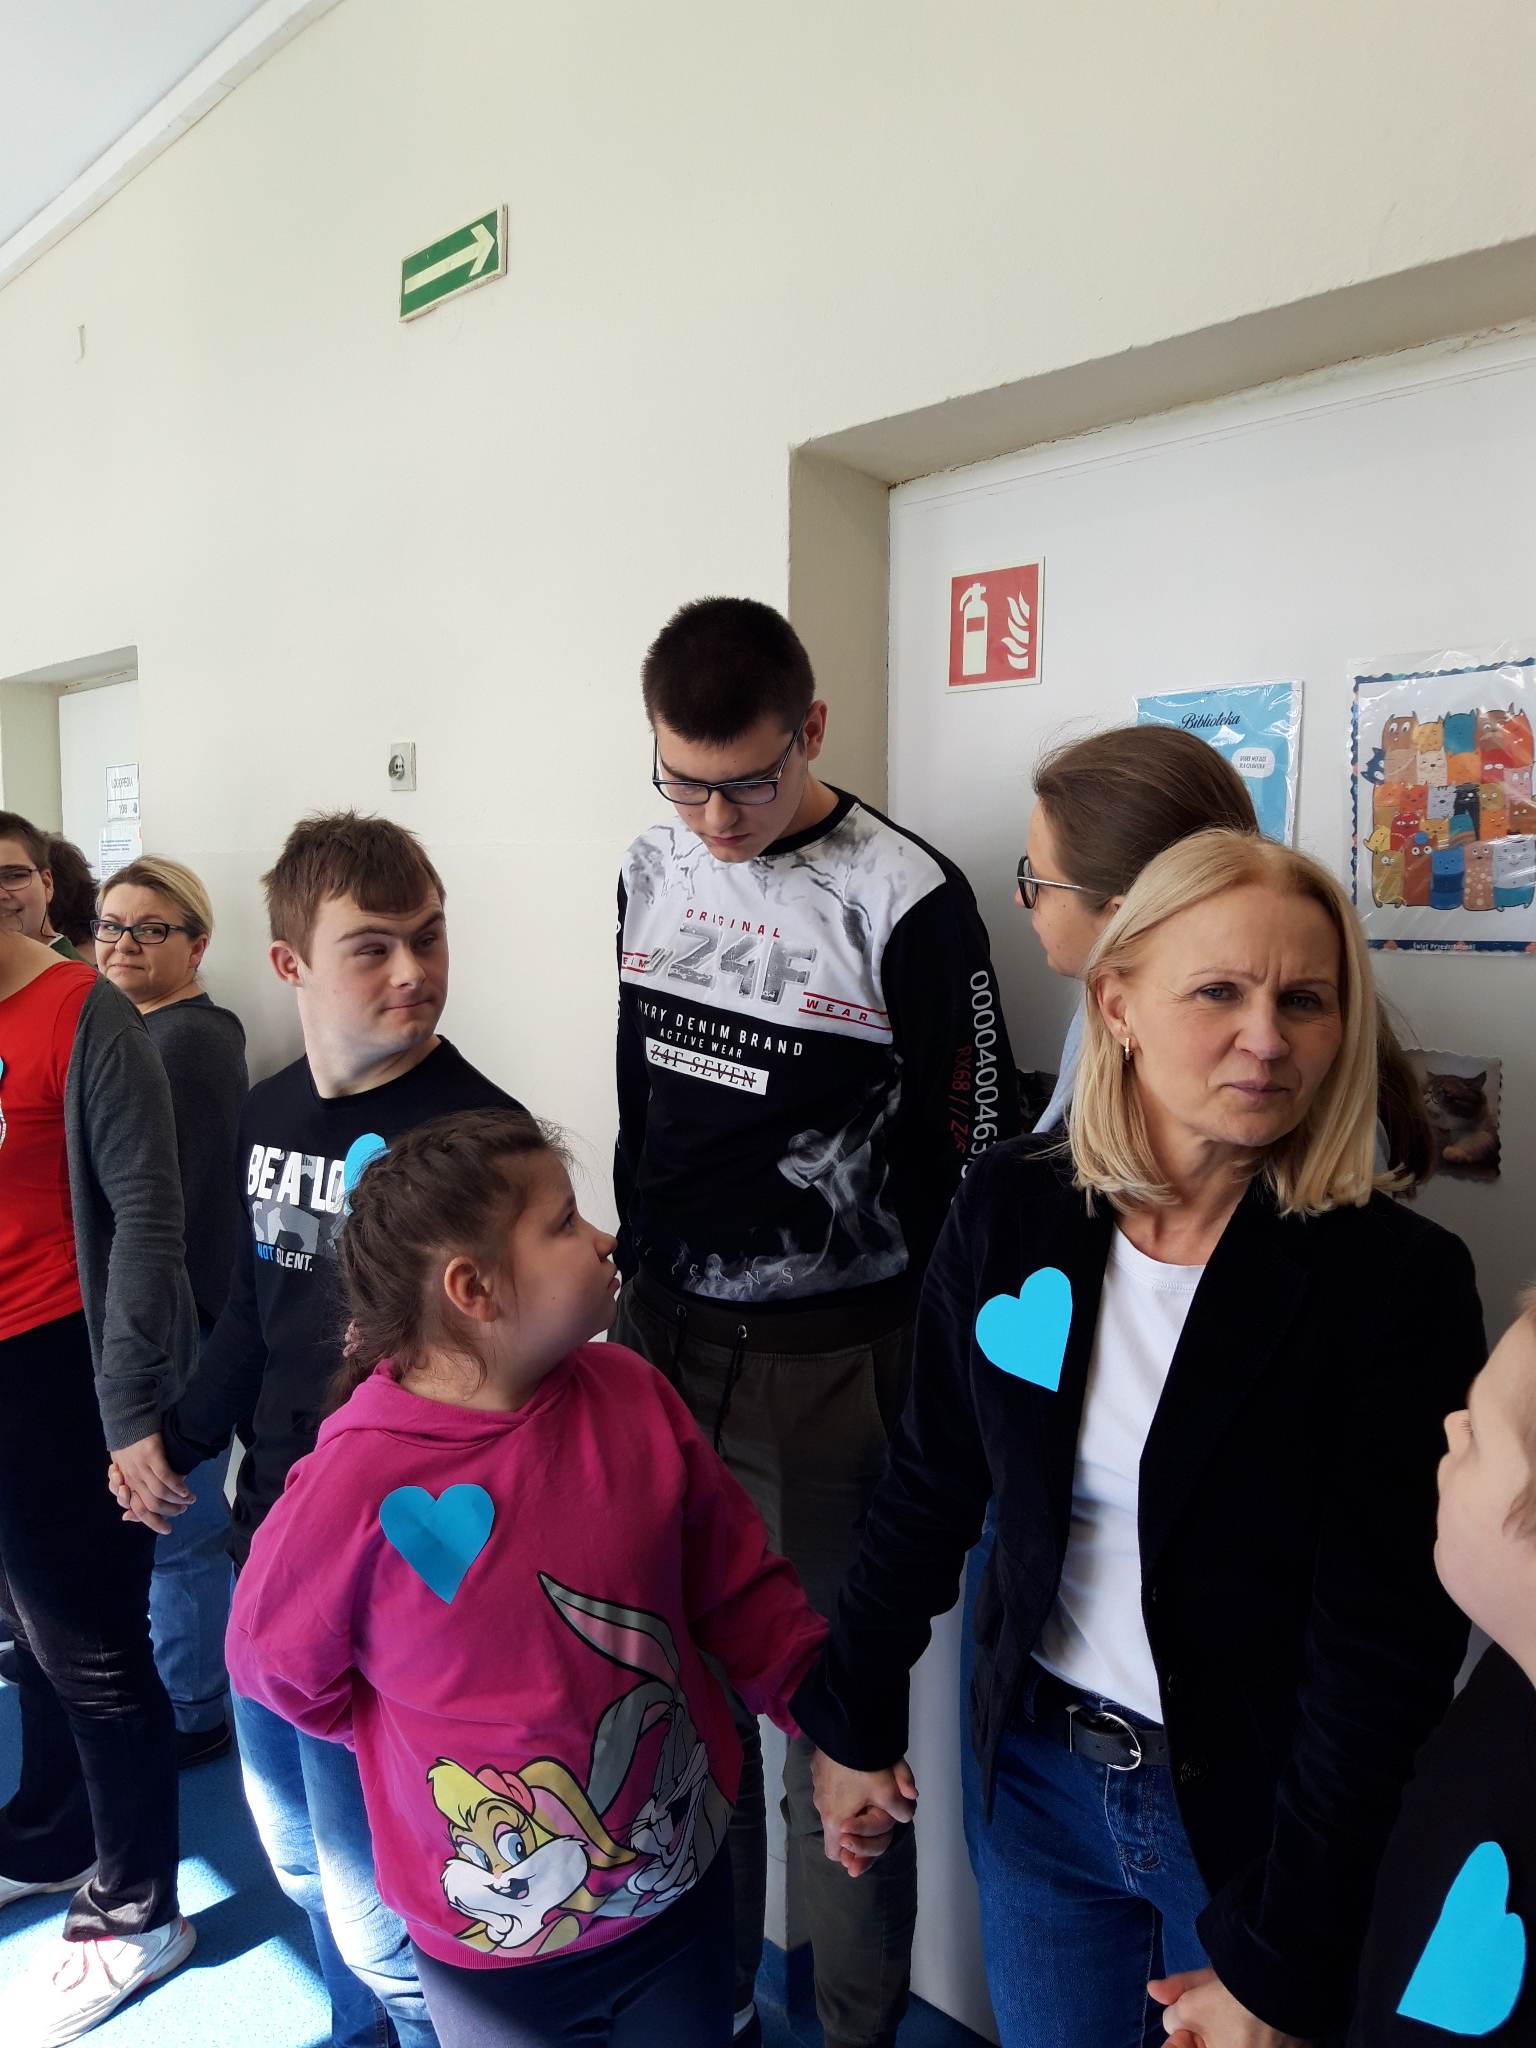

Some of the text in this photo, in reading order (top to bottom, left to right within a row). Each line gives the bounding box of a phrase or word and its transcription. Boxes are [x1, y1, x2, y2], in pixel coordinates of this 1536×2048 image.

[1179, 711, 1241, 730] Biblioteka
[686, 908, 780, 938] ORIGINAL
[806, 998, 868, 1021] WEAR
[660, 1027, 742, 1059] ACTIVE WEAR
[676, 1013, 730, 1040] DENIM
[740, 1029, 803, 1056] BRAND
[689, 1056, 756, 1089] SEVEN
[247, 1143, 346, 1214] BE A LO
[257, 1242, 275, 1261] NOT
